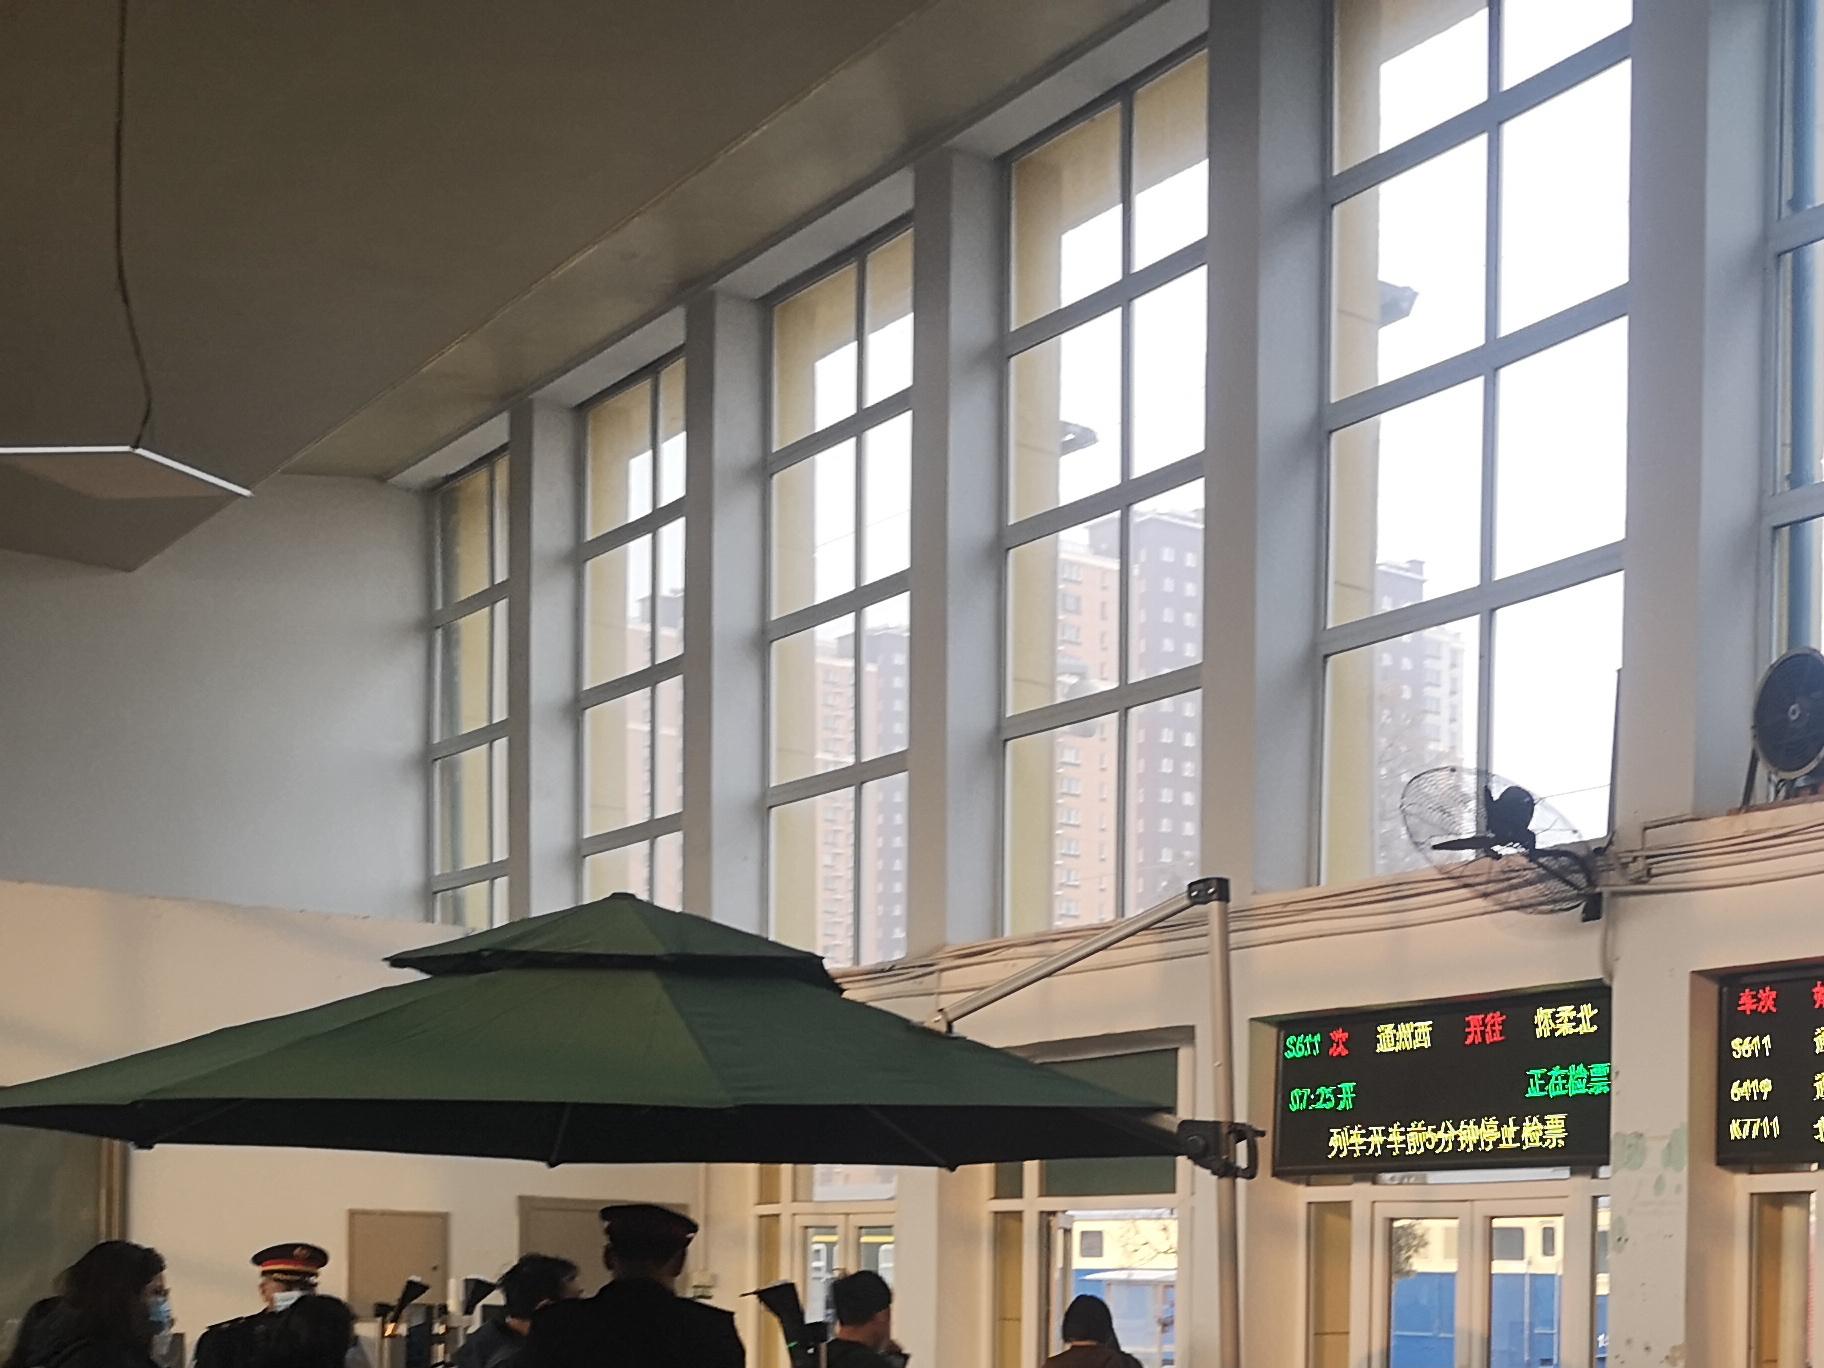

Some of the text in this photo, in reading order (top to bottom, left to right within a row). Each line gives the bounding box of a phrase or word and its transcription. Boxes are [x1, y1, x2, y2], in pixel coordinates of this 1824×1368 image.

[1738, 987, 1777, 1014] 车次
[1284, 1003, 1599, 1058] S611 次 通州西 开往 怀柔北
[1731, 1035, 1771, 1059] S611
[1525, 1062, 1611, 1098] 正在检票
[1327, 1113, 1568, 1158] 列车开车前5分钟停止检票
